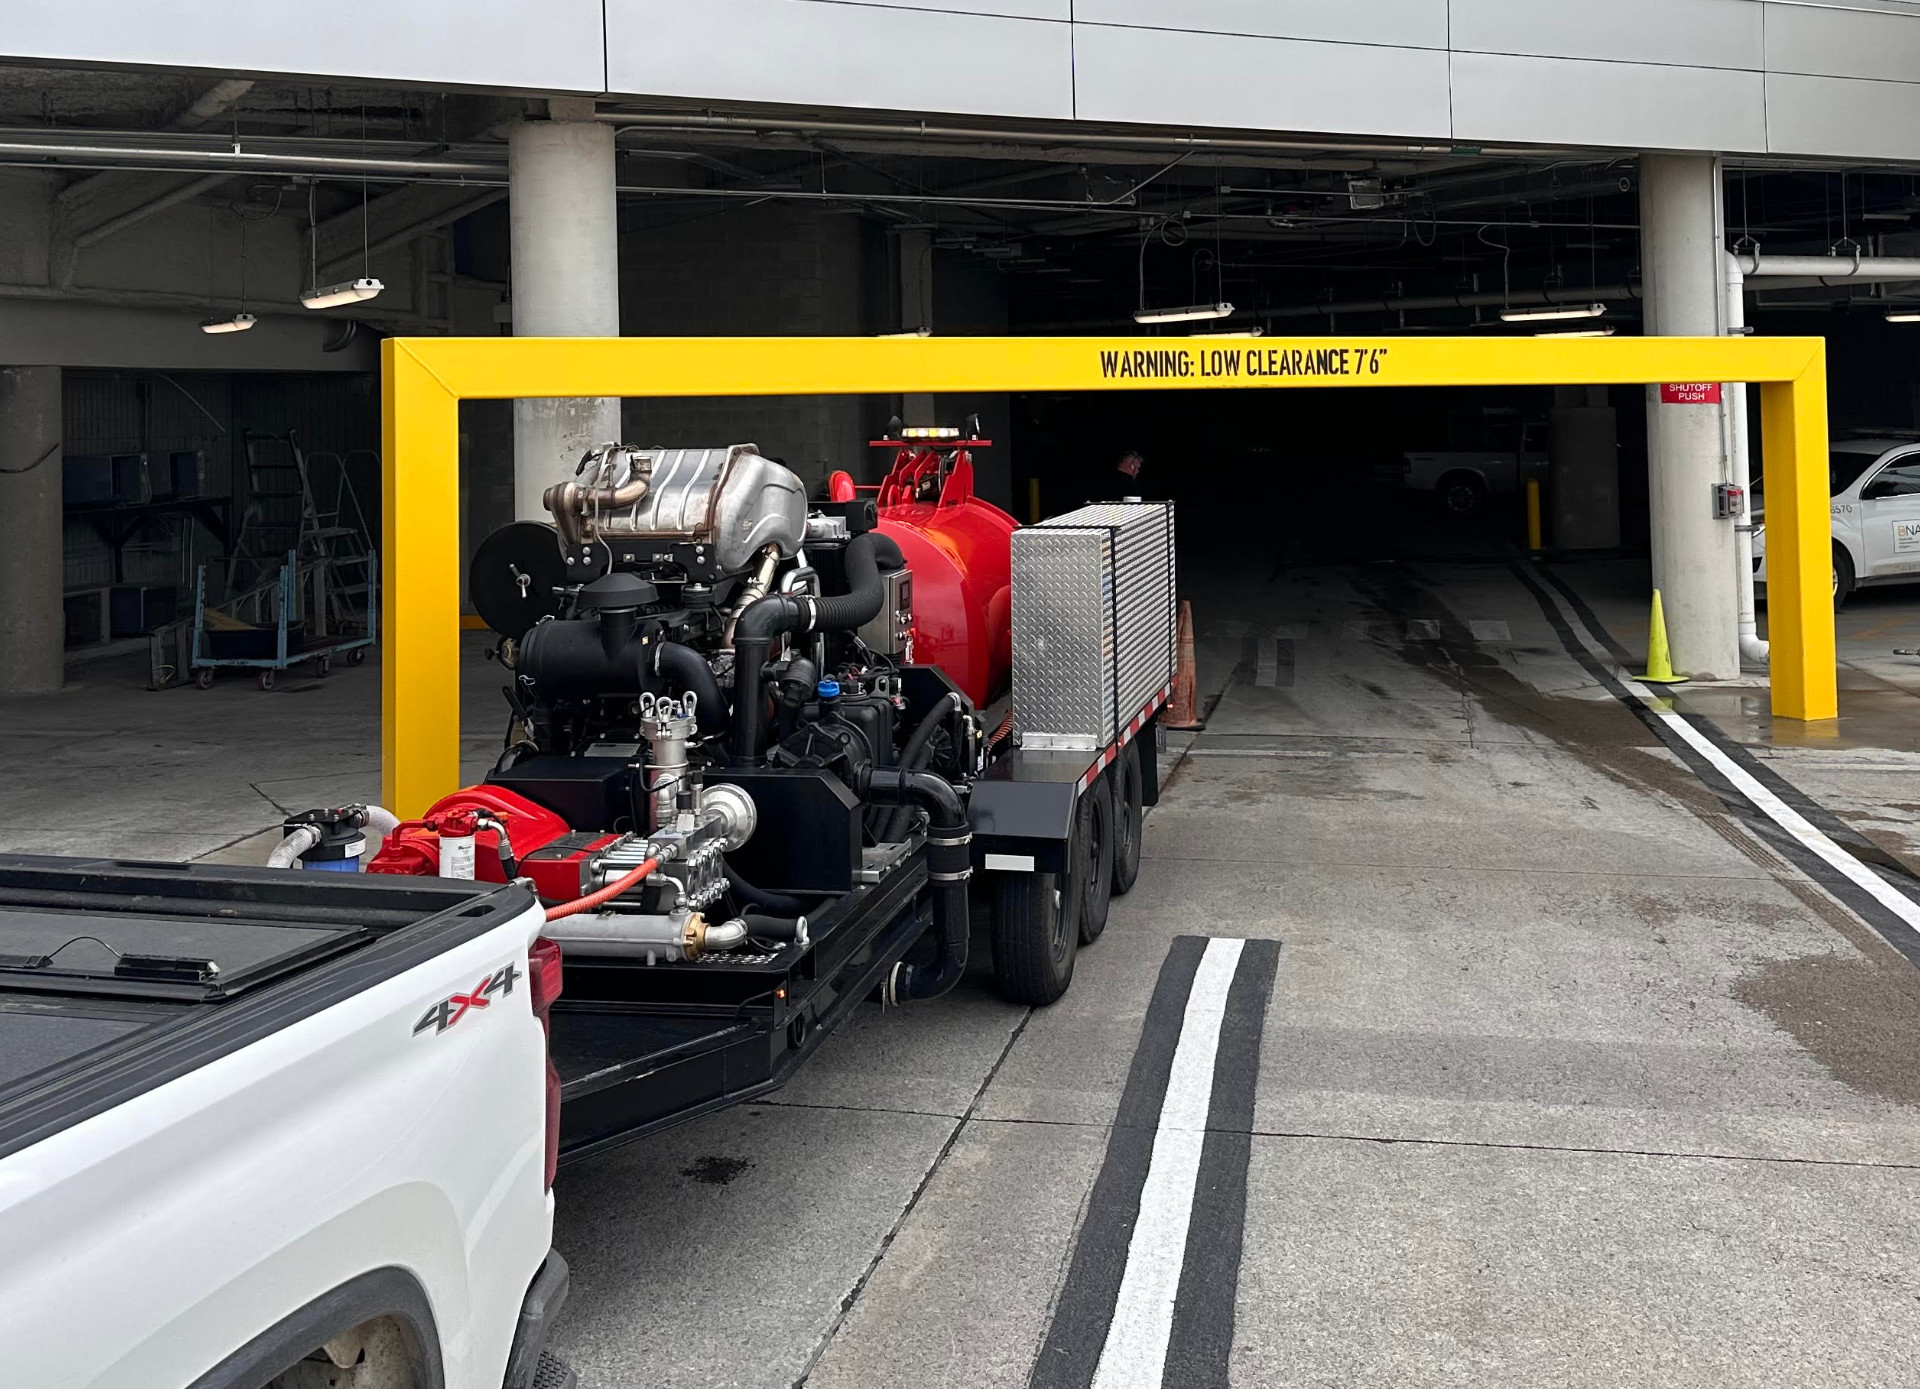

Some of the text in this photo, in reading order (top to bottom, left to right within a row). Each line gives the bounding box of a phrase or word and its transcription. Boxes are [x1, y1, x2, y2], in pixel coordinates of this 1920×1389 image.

[1100, 350, 1195, 378] WARNING:
[1200, 349, 1241, 376] LOW
[1246, 348, 1350, 376] CLEARANCE
[1669, 383, 1713, 392] SHUTOFF
[1678, 392, 1705, 401] PUSH
